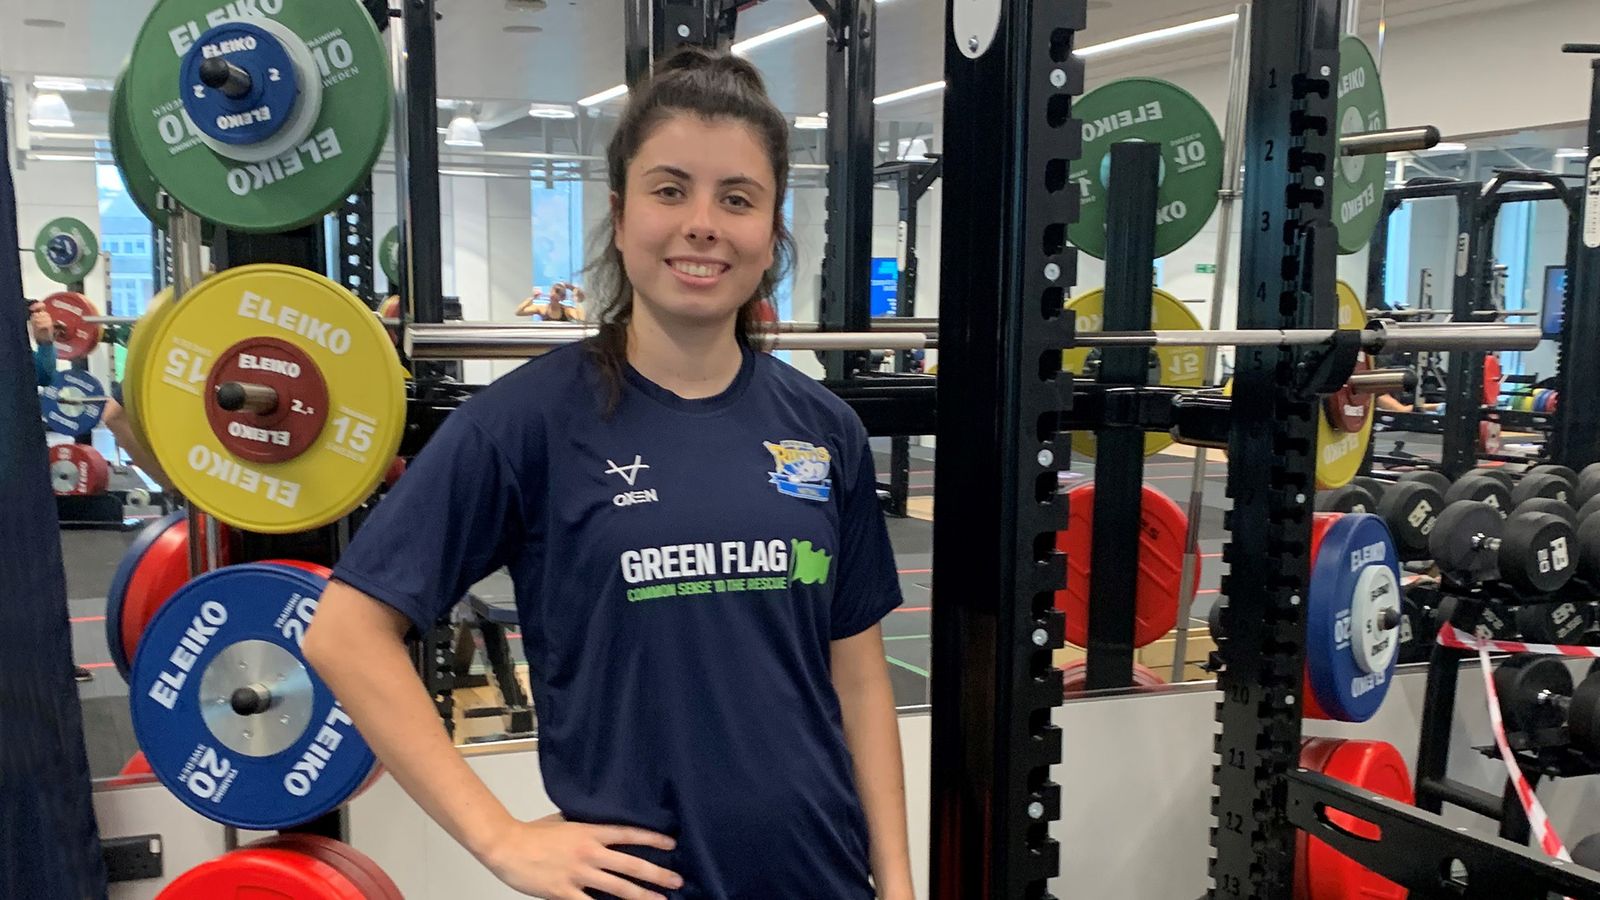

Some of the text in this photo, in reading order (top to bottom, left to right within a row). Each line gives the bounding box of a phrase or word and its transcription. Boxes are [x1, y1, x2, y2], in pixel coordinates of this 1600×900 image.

[202, 36, 257, 59] ELEIKO
[313, 38, 353, 77] 10
[320, 66, 360, 88] WEDEN
[1268, 68, 1277, 89] 1
[1337, 66, 1365, 99] LEIKO
[216, 105, 272, 130] ELEIKO
[227, 127, 343, 196] ELEIKO
[1264, 139, 1274, 161] 2
[1260, 211, 1270, 232] 3
[1256, 281, 1267, 302] 4
[237, 291, 351, 355] ELEIKO
[238, 353, 301, 378] ELEIKO
[228, 421, 290, 446] ELEIKO
[332, 416, 375, 452] 15
[187, 445, 300, 509] ELEIKO
[612, 488, 659, 506] OXEN
[621, 539, 788, 583] GREEN FLAG
[626, 584, 677, 602] COMMON
[677, 580, 712, 596] SENSE
[747, 577, 788, 590] RESCUE
[274, 592, 302, 628] TRAINING
[282, 597, 321, 648] 20
[148, 600, 229, 710] ELEIKO
[177, 743, 207, 782] SWEDEN
[283, 701, 353, 796] LEIKO
[1228, 747, 1246, 770] 11
[187, 747, 231, 799] 20
[211, 768, 239, 804] TRAINING
[1225, 811, 1243, 835] 12
